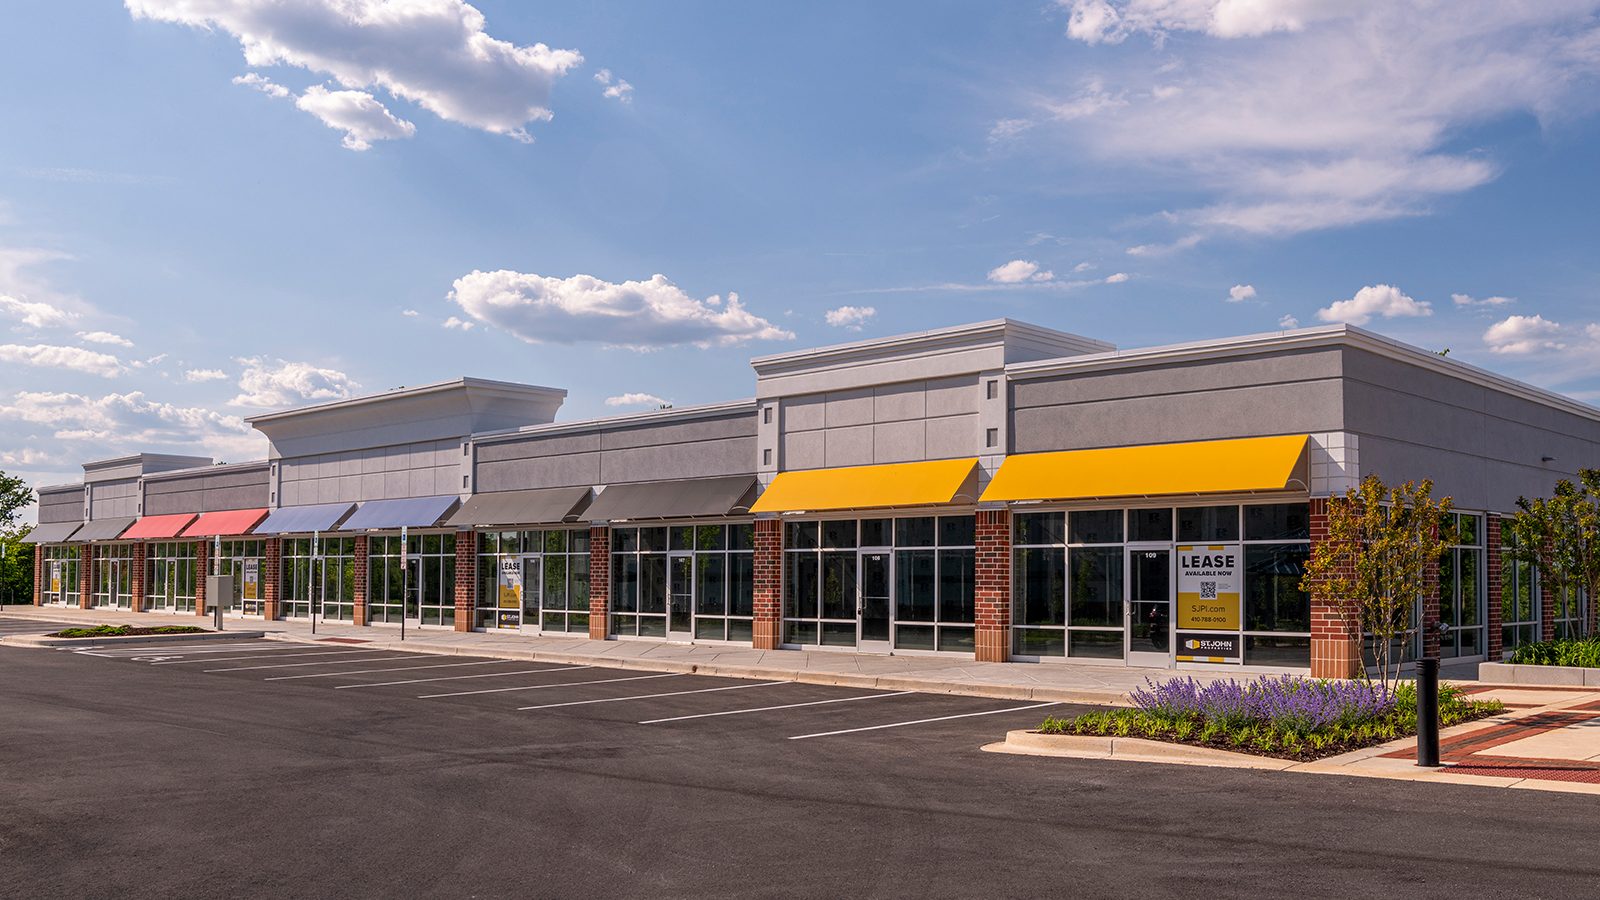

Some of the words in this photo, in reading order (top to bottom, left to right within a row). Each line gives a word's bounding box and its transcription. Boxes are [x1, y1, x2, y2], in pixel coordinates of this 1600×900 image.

[501, 562, 520, 570] LEASE
[1182, 555, 1235, 568] LEASE
[1191, 604, 1226, 613] SJPI.com
